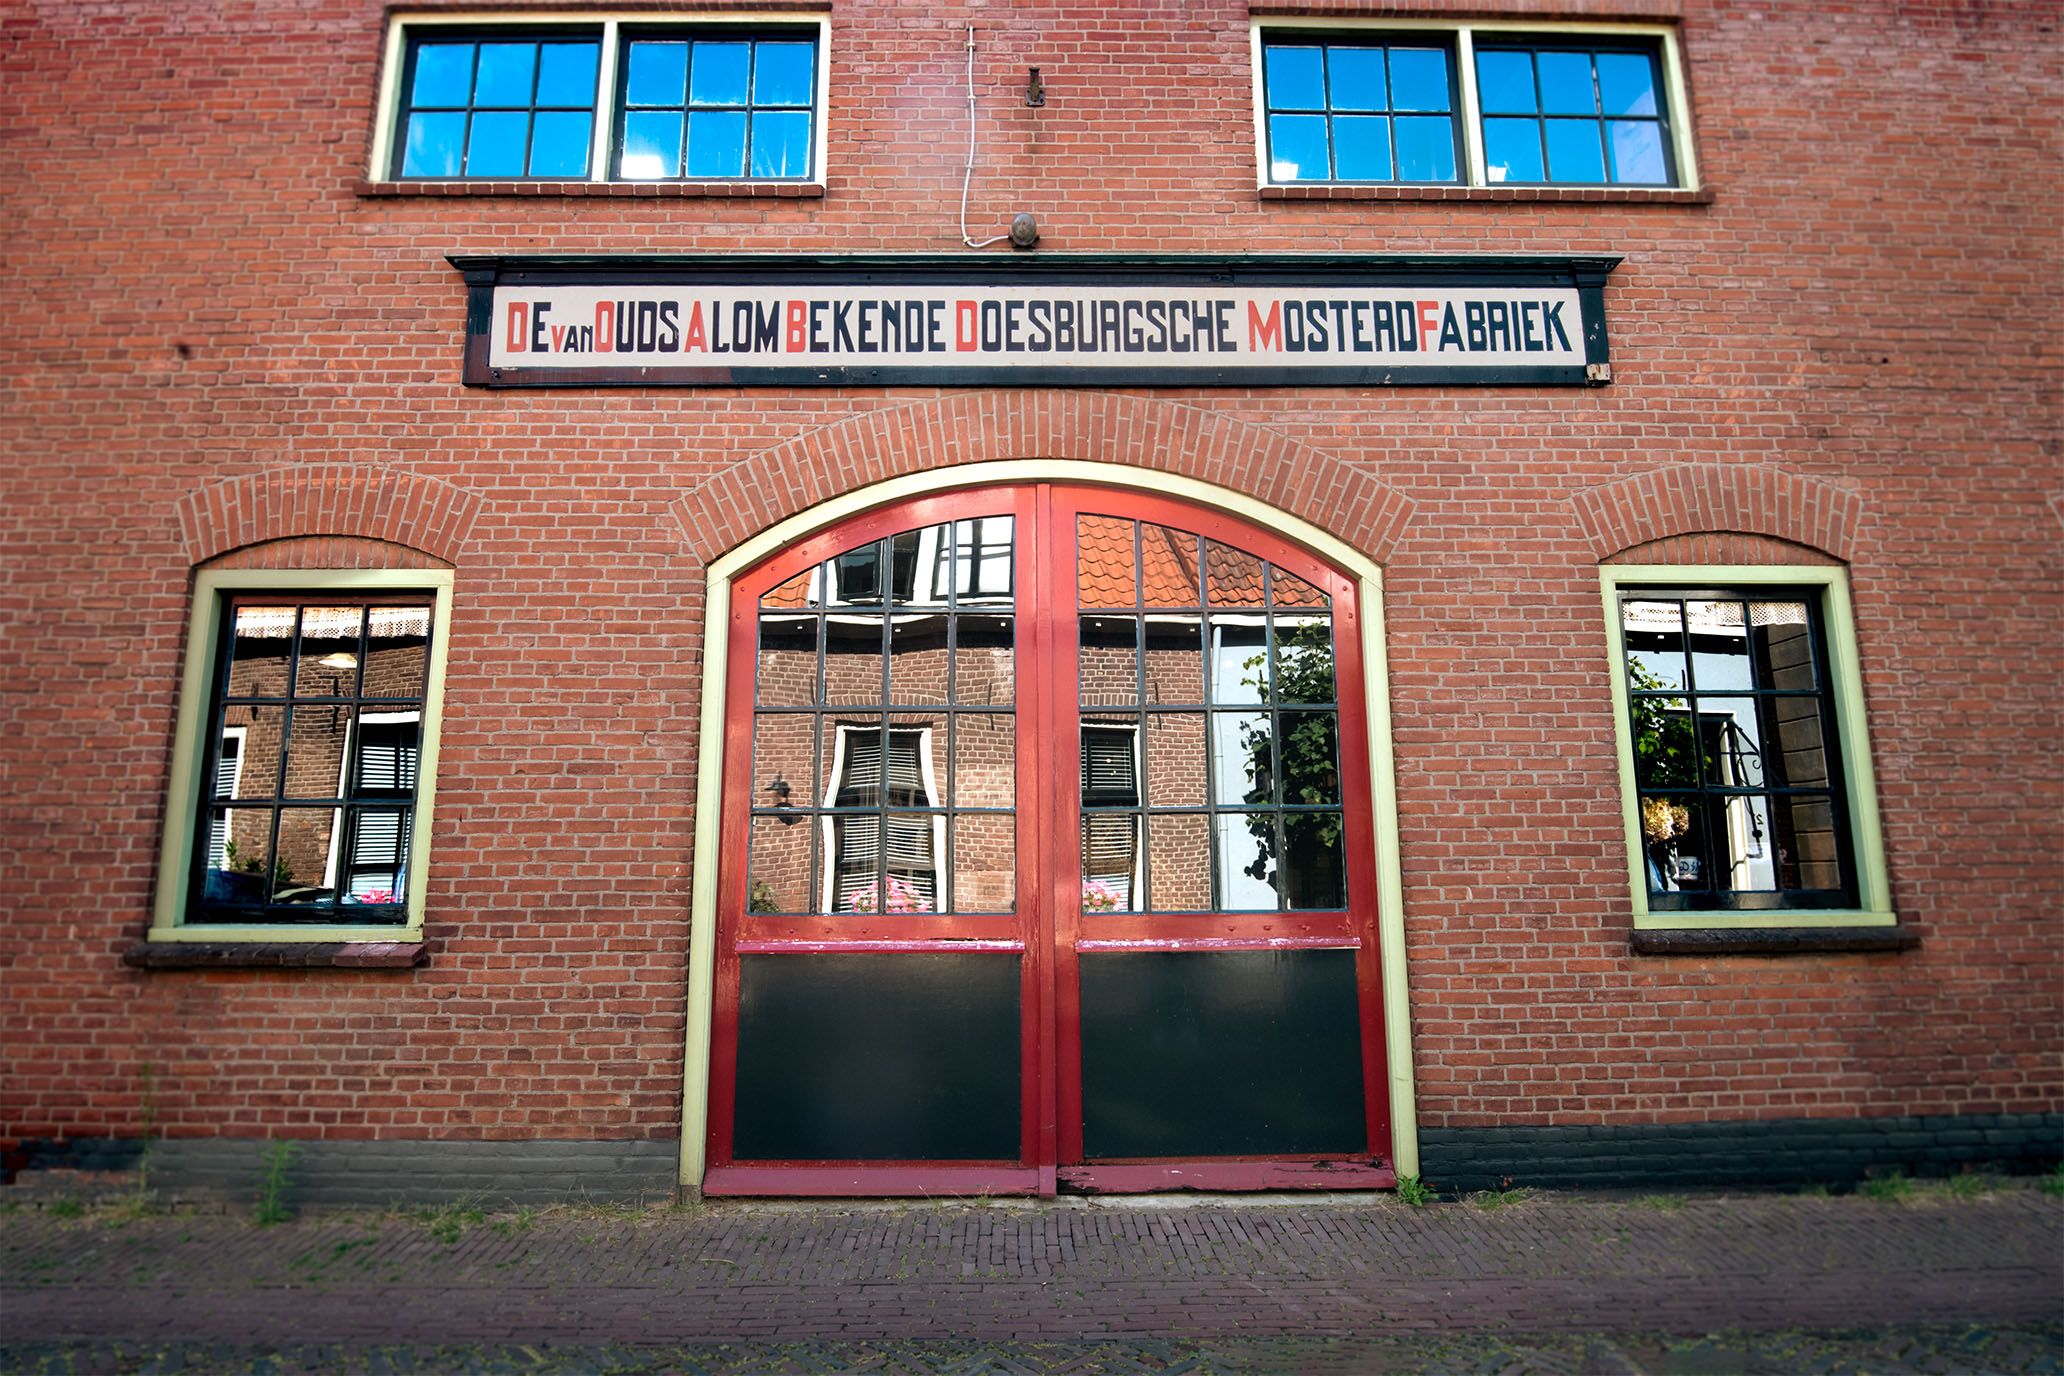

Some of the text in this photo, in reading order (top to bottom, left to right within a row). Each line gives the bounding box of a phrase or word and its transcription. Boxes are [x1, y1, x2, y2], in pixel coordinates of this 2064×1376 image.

[507, 302, 551, 352] DE
[595, 301, 679, 352] OUDS
[685, 301, 779, 352] ALOM
[787, 301, 945, 352] BEKENDE
[956, 301, 1237, 352] DOESBURGSCHE
